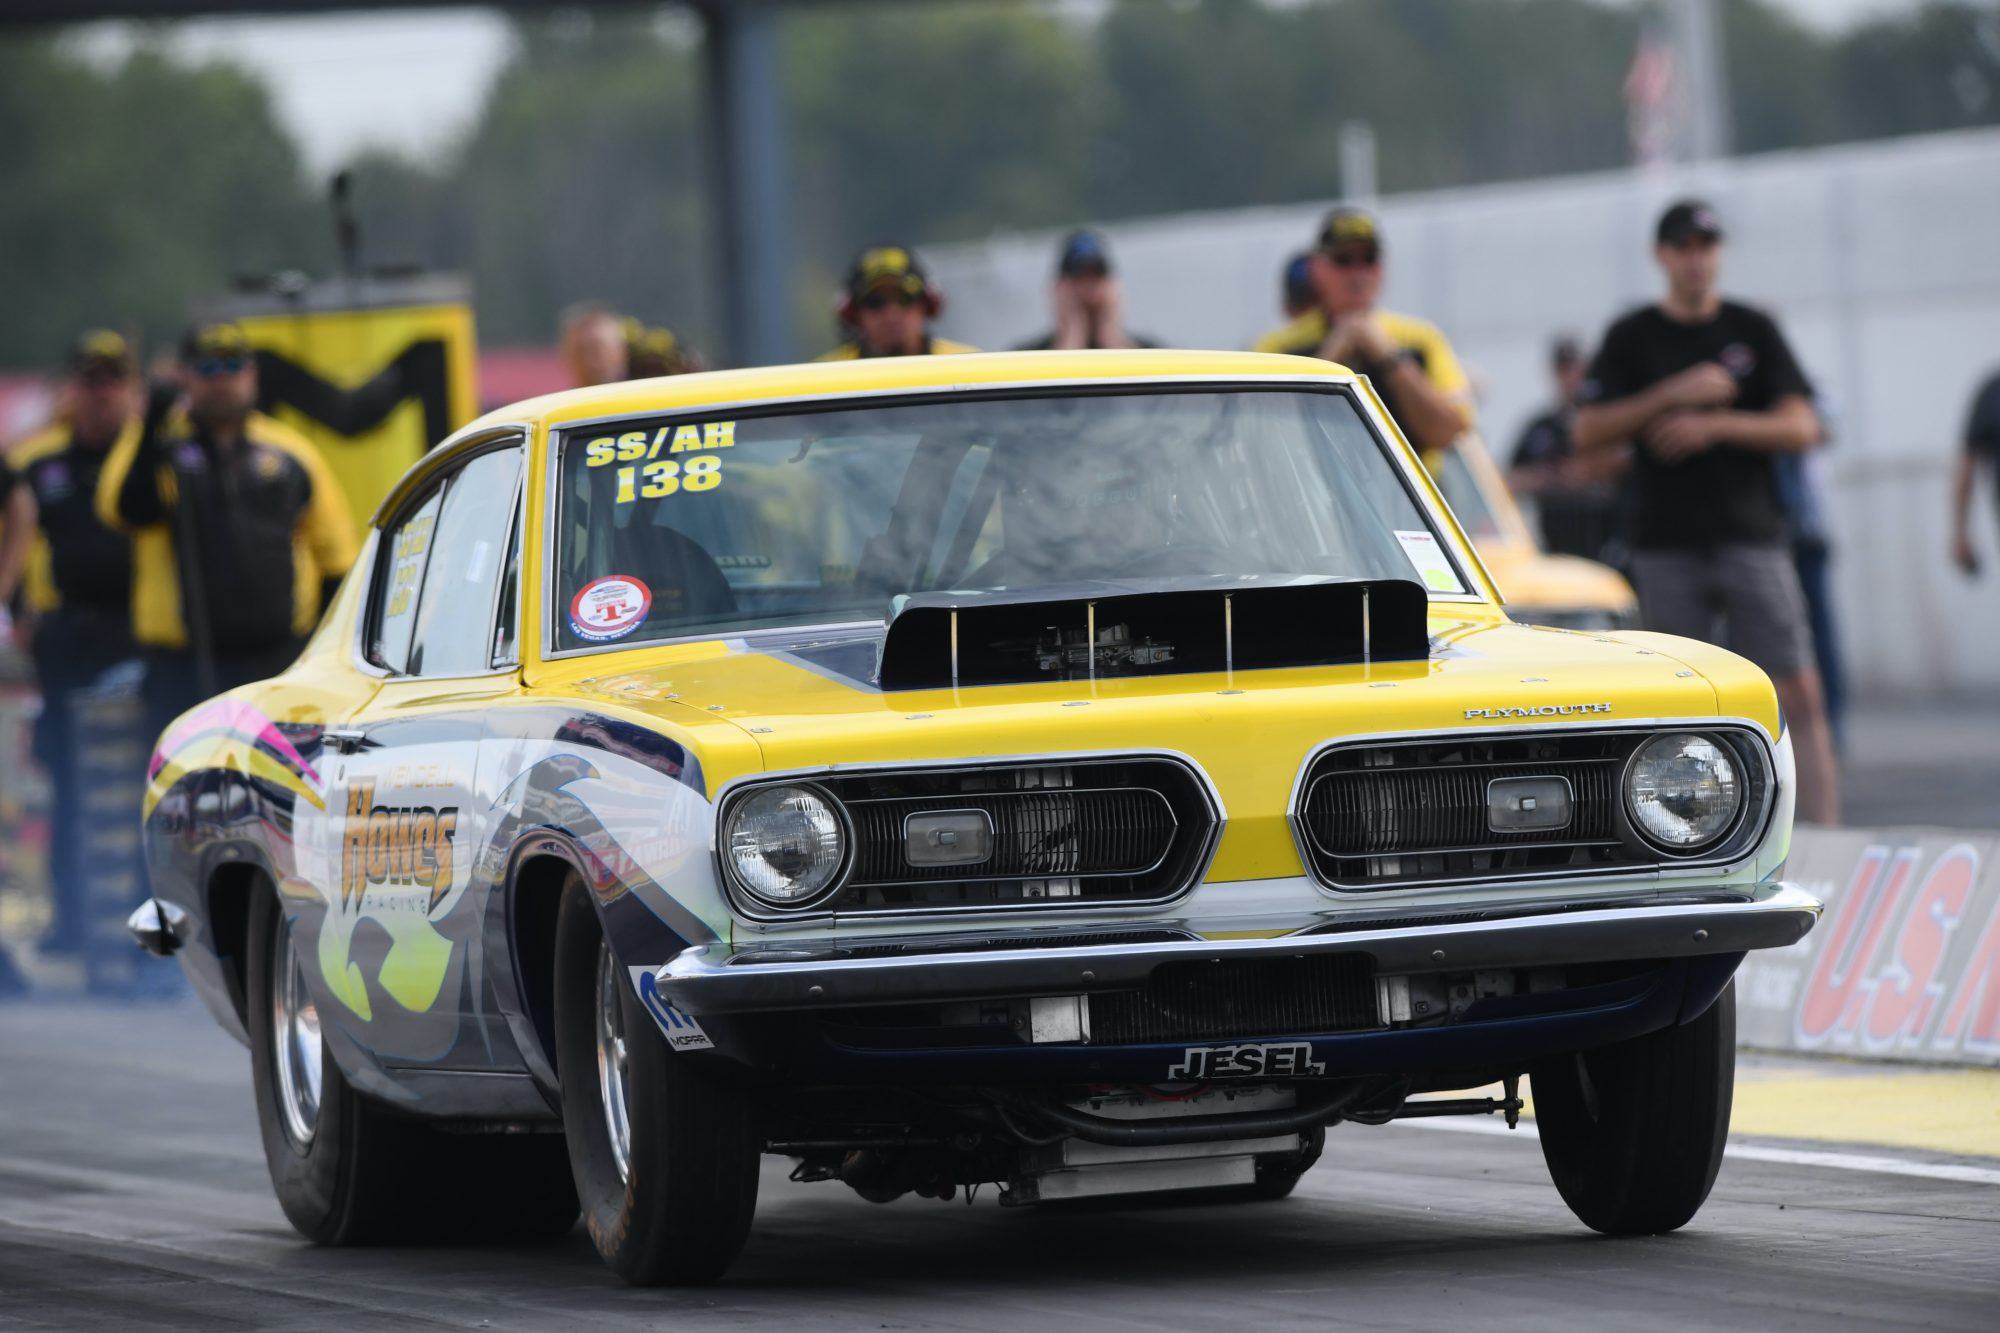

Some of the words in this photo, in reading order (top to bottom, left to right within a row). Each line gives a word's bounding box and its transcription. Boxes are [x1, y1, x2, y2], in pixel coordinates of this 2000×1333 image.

[586, 421, 736, 467] SS/AH
[616, 455, 722, 504] 138
[1464, 702, 1612, 719] PLYMOUTH
[671, 1035, 709, 1046] MOPAR
[1171, 1044, 1322, 1079] JESEL
